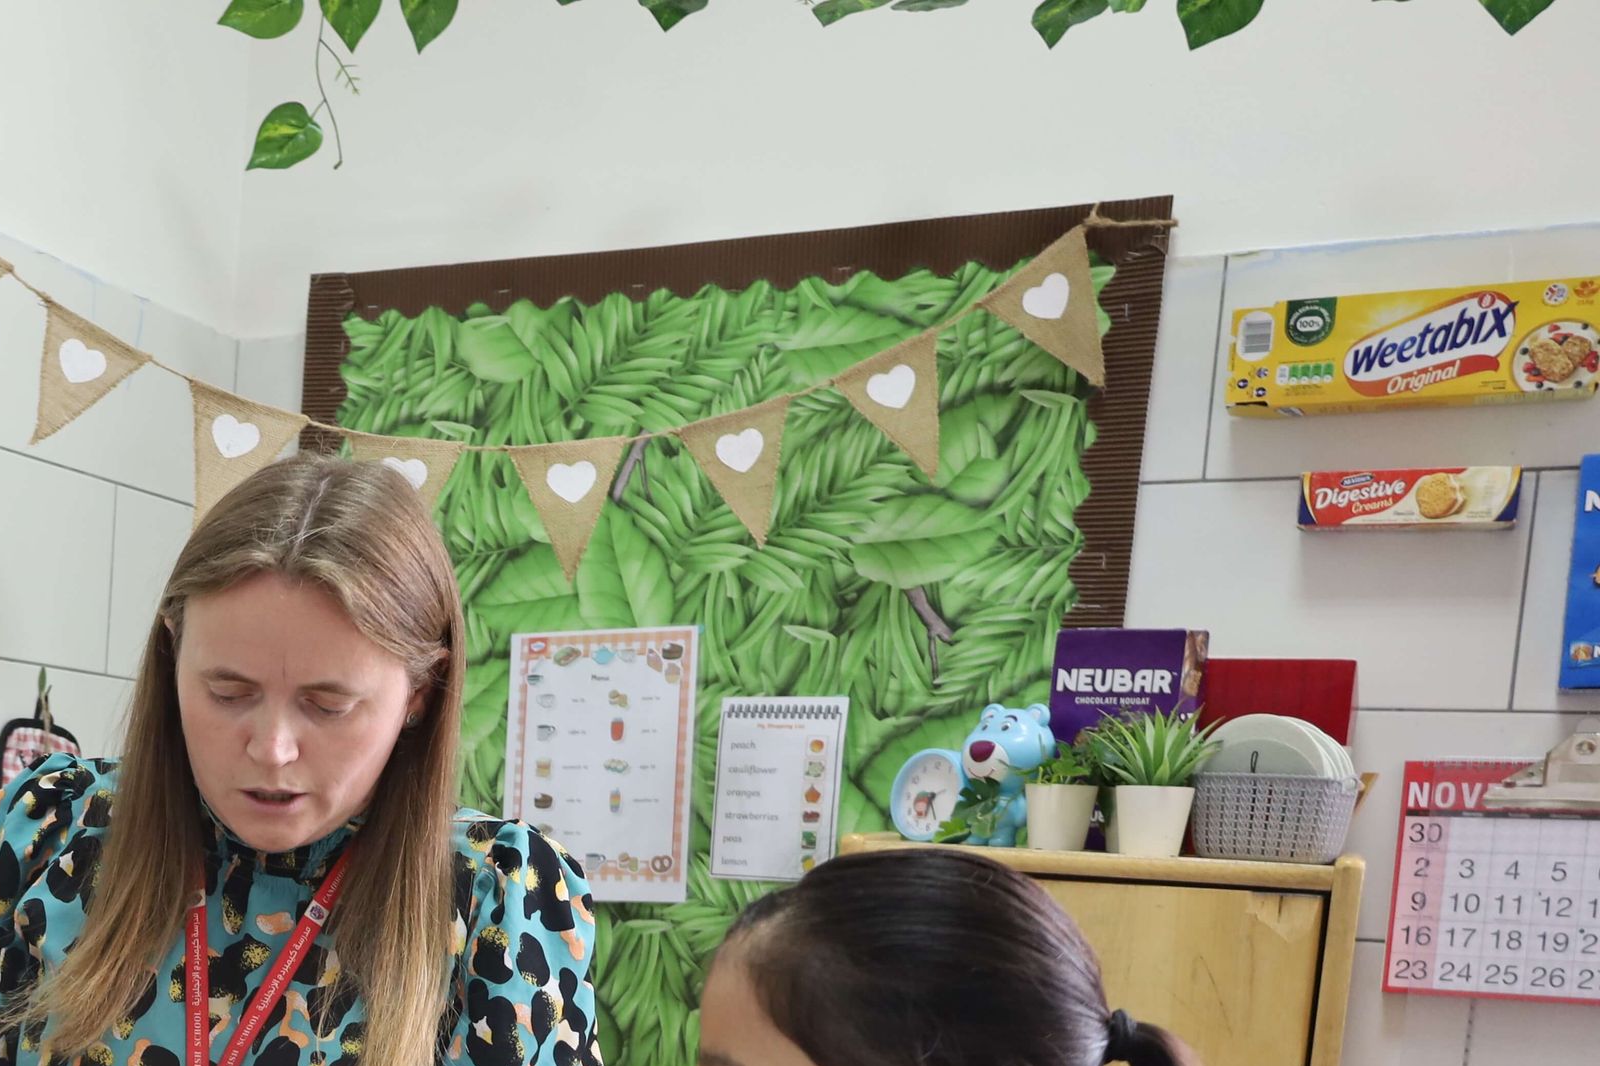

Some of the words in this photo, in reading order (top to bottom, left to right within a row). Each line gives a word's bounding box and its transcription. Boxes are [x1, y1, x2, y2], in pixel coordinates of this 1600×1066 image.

[1351, 300, 1520, 376] Weetabix
[1387, 359, 1460, 394] Original
[1314, 480, 1406, 510] Digestive
[1351, 498, 1394, 515] Creams
[1056, 668, 1172, 695] NEUBAR
[1074, 696, 1118, 705] CHOCOLATE
[1119, 697, 1150, 705] NOUGAT
[730, 740, 756, 750] peach
[728, 765, 778, 776] cauliflower
[726, 790, 761, 799] oranges
[1408, 781, 1499, 810] NOV
[725, 812, 779, 822] strawberries
[722, 835, 742, 844] peas
[1409, 822, 1443, 844] 30
[721, 857, 747, 866] lemon
[1413, 857, 1430, 877] 2
[1458, 858, 1475, 879] 3
[1504, 860, 1520, 880] 4
[1551, 862, 1567, 882] 5
[1410, 891, 1427, 912] 9
[1450, 893, 1481, 914] 10
[1495, 894, 1522, 916] 11
[1542, 896, 1573, 918] 12
[1401, 925, 1431, 946] 16
[1446, 927, 1477, 948] 17
[1491, 928, 1522, 951] 18
[1537, 930, 1570, 953] 19
[1394, 959, 1428, 980] 23
[1439, 961, 1473, 983] 24
[1484, 964, 1518, 986] 25
[1530, 966, 1565, 988] 26
[194, 1010, 203, 1047] SCHOOL
[237, 1013, 261, 1048] SCHOOL
